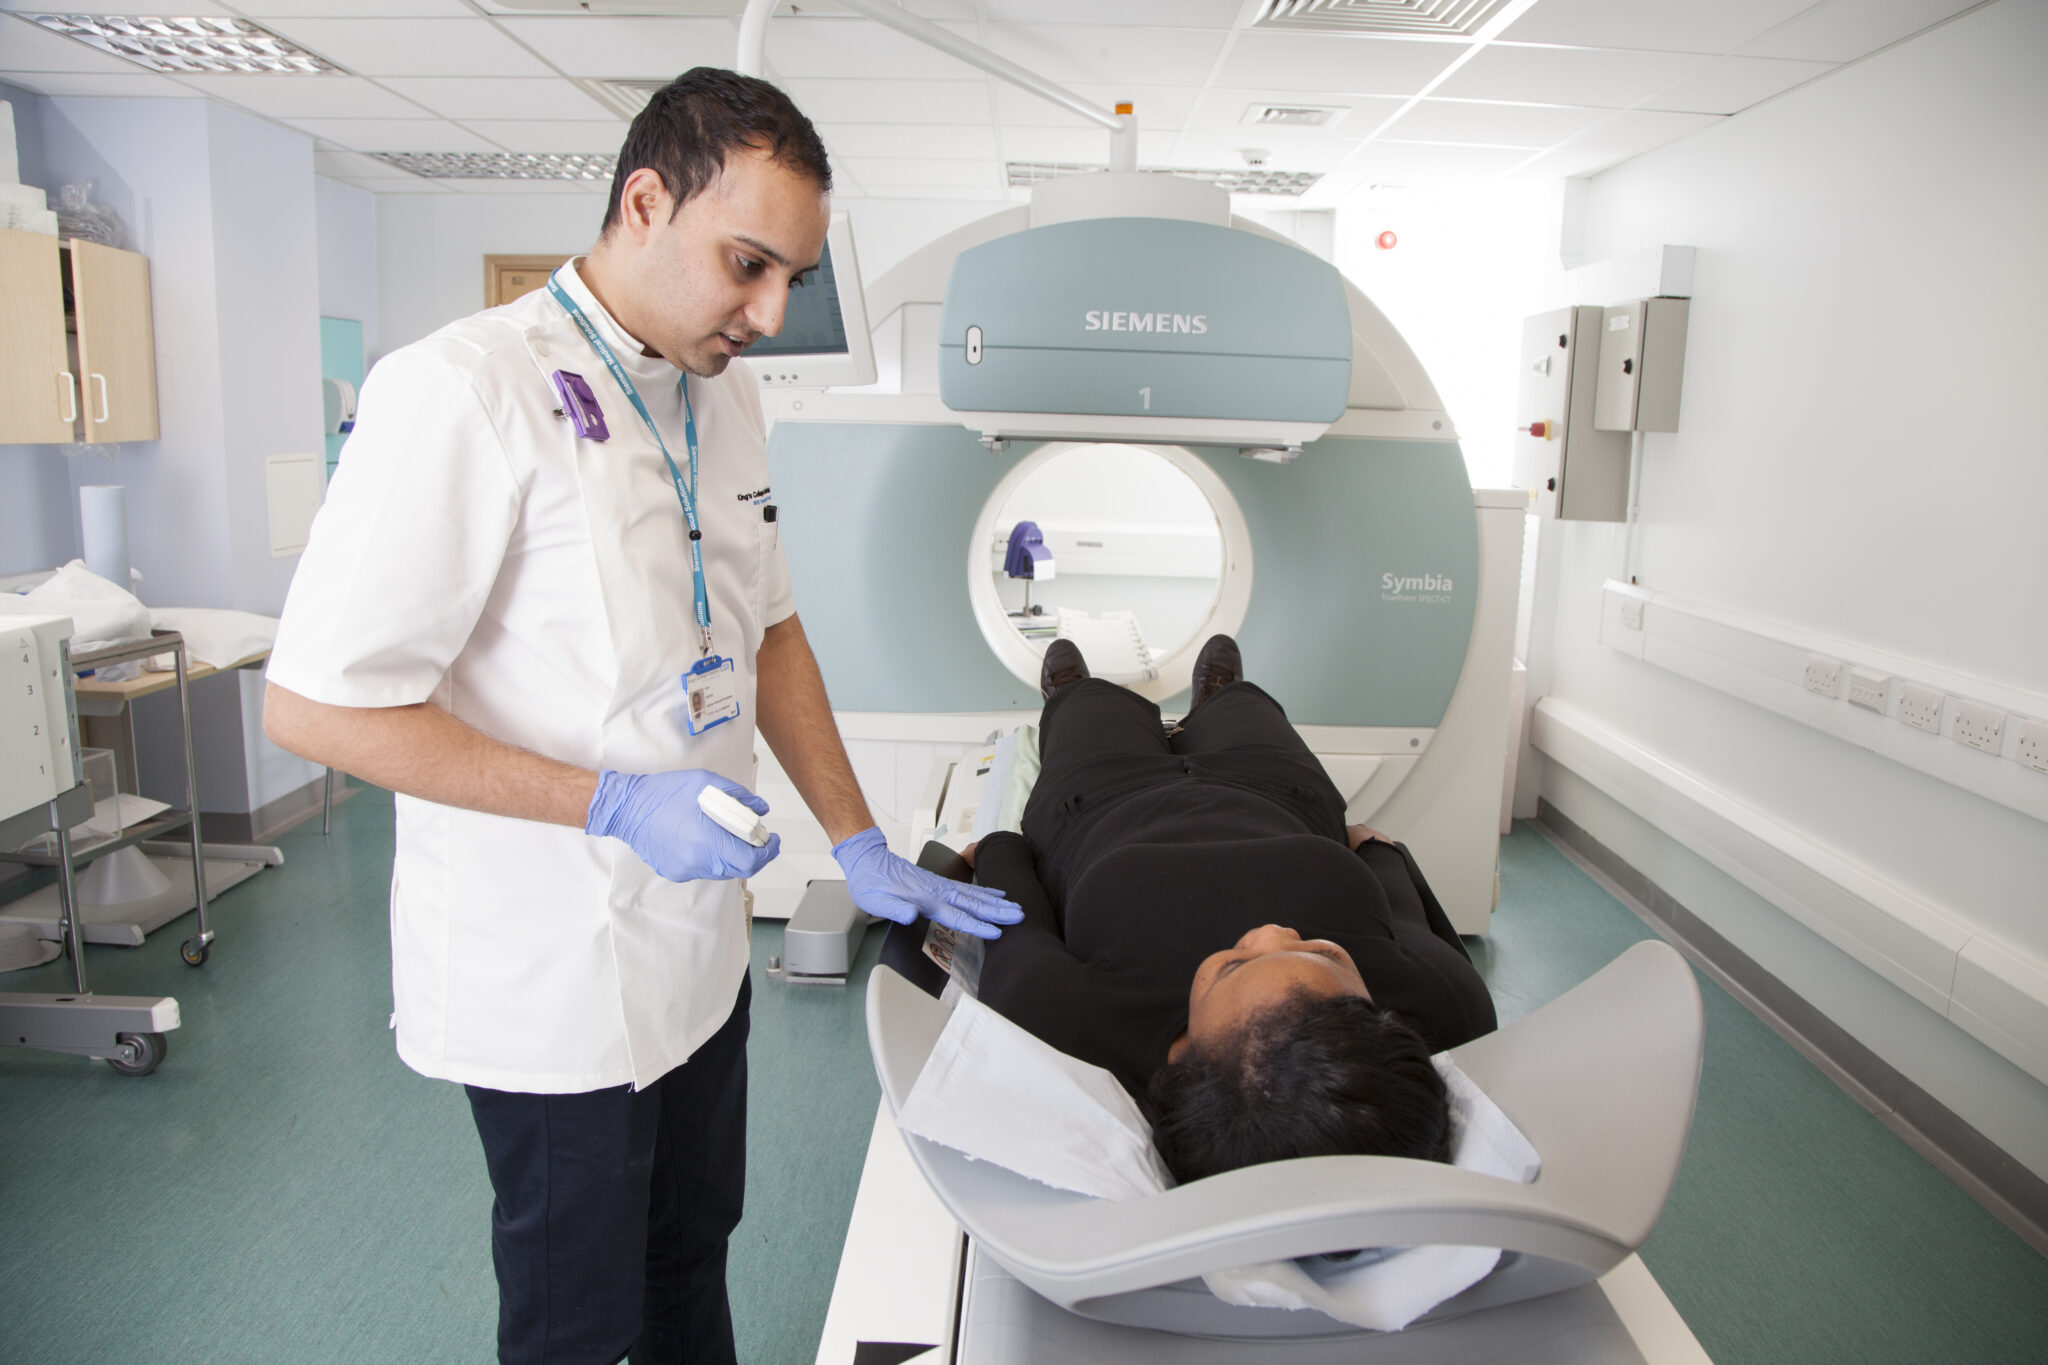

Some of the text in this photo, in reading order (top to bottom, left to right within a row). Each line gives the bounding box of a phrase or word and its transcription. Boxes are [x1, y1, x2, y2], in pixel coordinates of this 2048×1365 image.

[1085, 310, 1208, 334] SIEMENS
[572, 308, 633, 395] Siemens Medical Solutions
[1138, 386, 1151, 410] 1
[677, 478, 692, 512] Solutions
[692, 541, 700, 572] Siemens
[1382, 572, 1453, 594] Symbia
[696, 601, 705, 625] utions
[22, 653, 29, 664] 4
[27, 684, 34, 696] 3
[33, 725, 39, 736] 2
[40, 765, 45, 775] 1
